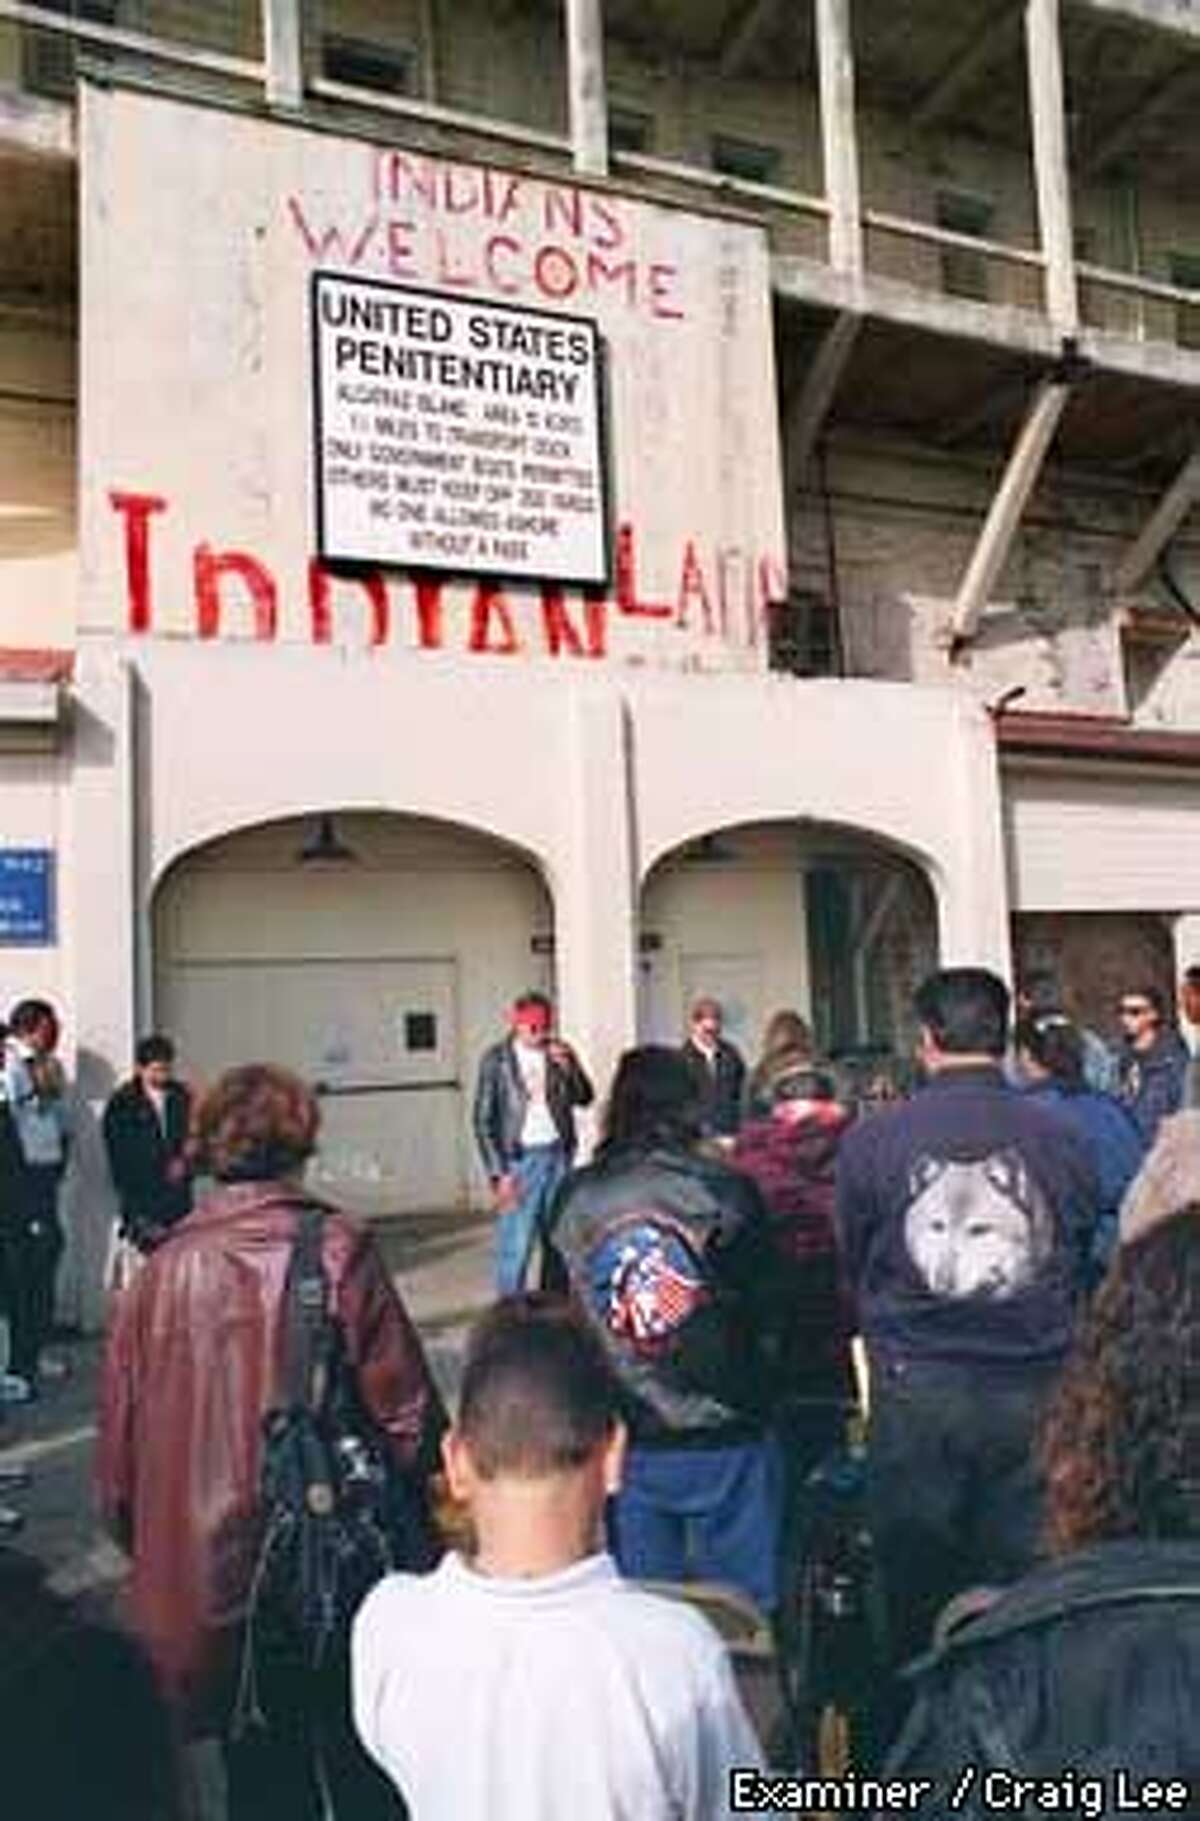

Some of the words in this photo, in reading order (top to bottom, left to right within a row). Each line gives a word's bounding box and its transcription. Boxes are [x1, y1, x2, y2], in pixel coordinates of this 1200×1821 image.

[287, 195, 684, 319] WELCOME
[321, 292, 452, 343] UNITED
[468, 316, 590, 366] STATES
[335, 336, 581, 402] PENITENTIARY
